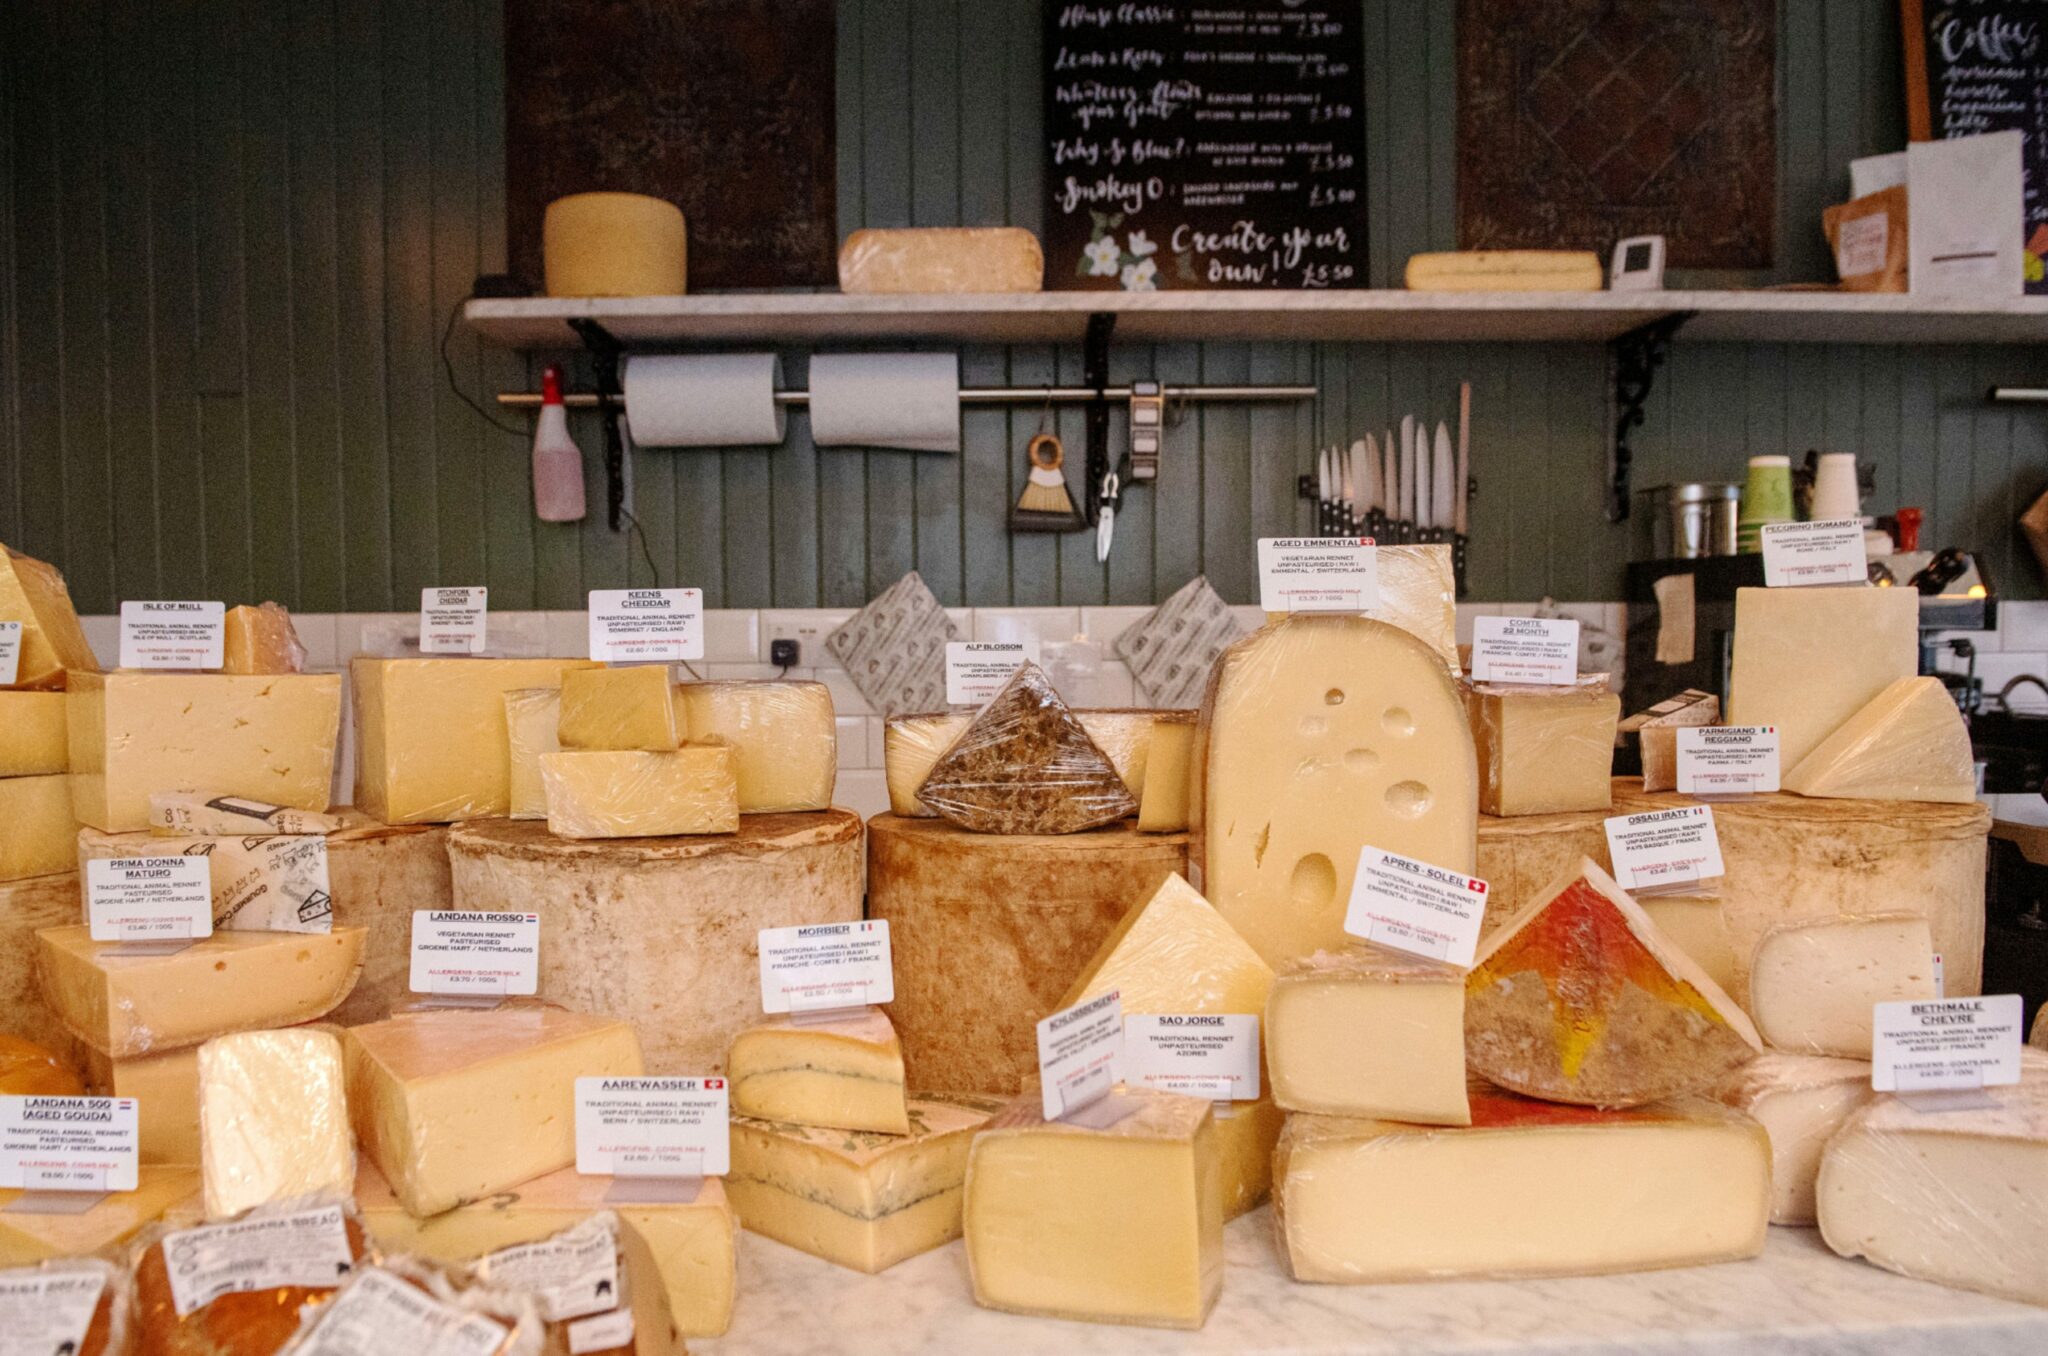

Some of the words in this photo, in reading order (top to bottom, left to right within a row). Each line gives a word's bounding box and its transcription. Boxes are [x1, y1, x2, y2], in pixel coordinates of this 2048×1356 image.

[1171, 220, 1275, 254] Create
[1282, 226, 1350, 269] your
[1765, 524, 1811, 534] PECORINO
[1813, 520, 1852, 530] ROMANO
[1304, 539, 1361, 547] EMMENTAL
[1772, 536, 1809, 544] TRADITIONAL
[628, 590, 662, 599] KEENS
[439, 597, 468, 605] CHEDDAR
[621, 600, 670, 609] CHEDDAR
[143, 603, 161, 611] ISLE
[164, 603, 175, 611] OF
[178, 603, 202, 611] MULL
[607, 620, 662, 628] UNPASTEURISED
[1509, 619, 1542, 627] COMTE
[1503, 627, 1515, 635] 22
[1516, 627, 1549, 636] MONTH
[966, 643, 982, 651] ALP
[984, 643, 1023, 651] BLOSSOM
[1480, 638, 1520, 646] TRADITIONAL
[1699, 727, 1755, 736] PARMIGIANO
[1705, 735, 1752, 744] REGGIANO
[1628, 813, 1659, 824] OSSAU
[1662, 809, 1688, 820] IRATY
[1615, 829, 1656, 841] TRADITIONAL
[1657, 826, 1680, 835] ANIMAL
[1682, 822, 1707, 832] RENNET
[1626, 843, 1643, 852] PAYS
[1644, 840, 1670, 849] BASQUE
[1676, 836, 1702, 845] FRANCE
[110, 859, 144, 869] PRIMA
[146, 858, 185, 868] DONNA
[126, 869, 171, 879] MATURO
[1381, 854, 1419, 874] APRES
[1426, 867, 1465, 887] SOLEIL
[96, 883, 141, 891] TRADITIONAL
[144, 882, 171, 890] ANIMAL
[172, 881, 201, 889] RENNET
[1366, 866, 1415, 888] TRADITIONAL
[1417, 881, 1445, 896] ANIMAL
[1447, 890, 1477, 906] RENNET
[124, 889, 173, 897] PASTEURISED
[95, 897, 124, 905] GROENE
[152, 895, 205, 904] NETHERLANDS
[1367, 883, 1409, 903] EMMENTAL
[1416, 898, 1470, 920] SWITZERLAND
[430, 912, 484, 922] LANDANA
[486, 913, 523, 922] ROSSO
[485, 931, 515, 939] RENNET
[798, 925, 850, 937] MORBIER
[450, 938, 501, 946] PASTEURISED
[418, 944, 449, 952] GROENE
[478, 945, 533, 953] NETHERLANDS
[768, 945, 817, 956] TRADITIONAL
[821, 942, 849, 952] ANIMAL
[851, 940, 881, 949] RENNET
[772, 960, 809, 970] FRANCHE
[814, 958, 840, 967] COMTE
[848, 954, 880, 964] FRANCE
[1911, 1002, 1982, 1015] BETHMALE
[1159, 1016, 1183, 1026] SAO
[1186, 1016, 1224, 1026] JORGE
[1921, 1013, 1975, 1025] CHEVRE
[1884, 1029, 1939, 1039] TRADITIONAL
[1942, 1027, 1974, 1036] ANIMAL
[1977, 1025, 2012, 1034] RENNET
[602, 1080, 696, 1090] AAREWASSER
[25, 1098, 85, 1109] LANDANA
[88, 1100, 111, 1110] 500
[585, 1100, 642, 1108] TRADITIONAL
[646, 1100, 679, 1108] ANIMAL
[681, 1100, 717, 1108] RENNET
[22, 1110, 61, 1120] (AGED
[63, 1110, 112, 1121] GOUDA)
[599, 1109, 672, 1117] UNPASTEURISED
[7, 1127, 59, 1136] TRADITIONAL
[62, 1128, 92, 1136] ANIMAL
[95, 1129, 129, 1137] RENNET
[4, 1143, 38, 1151] GROENE
[71, 1144, 131, 1153] NETHERLANDS
[291, 1213, 339, 1227] BREAD
